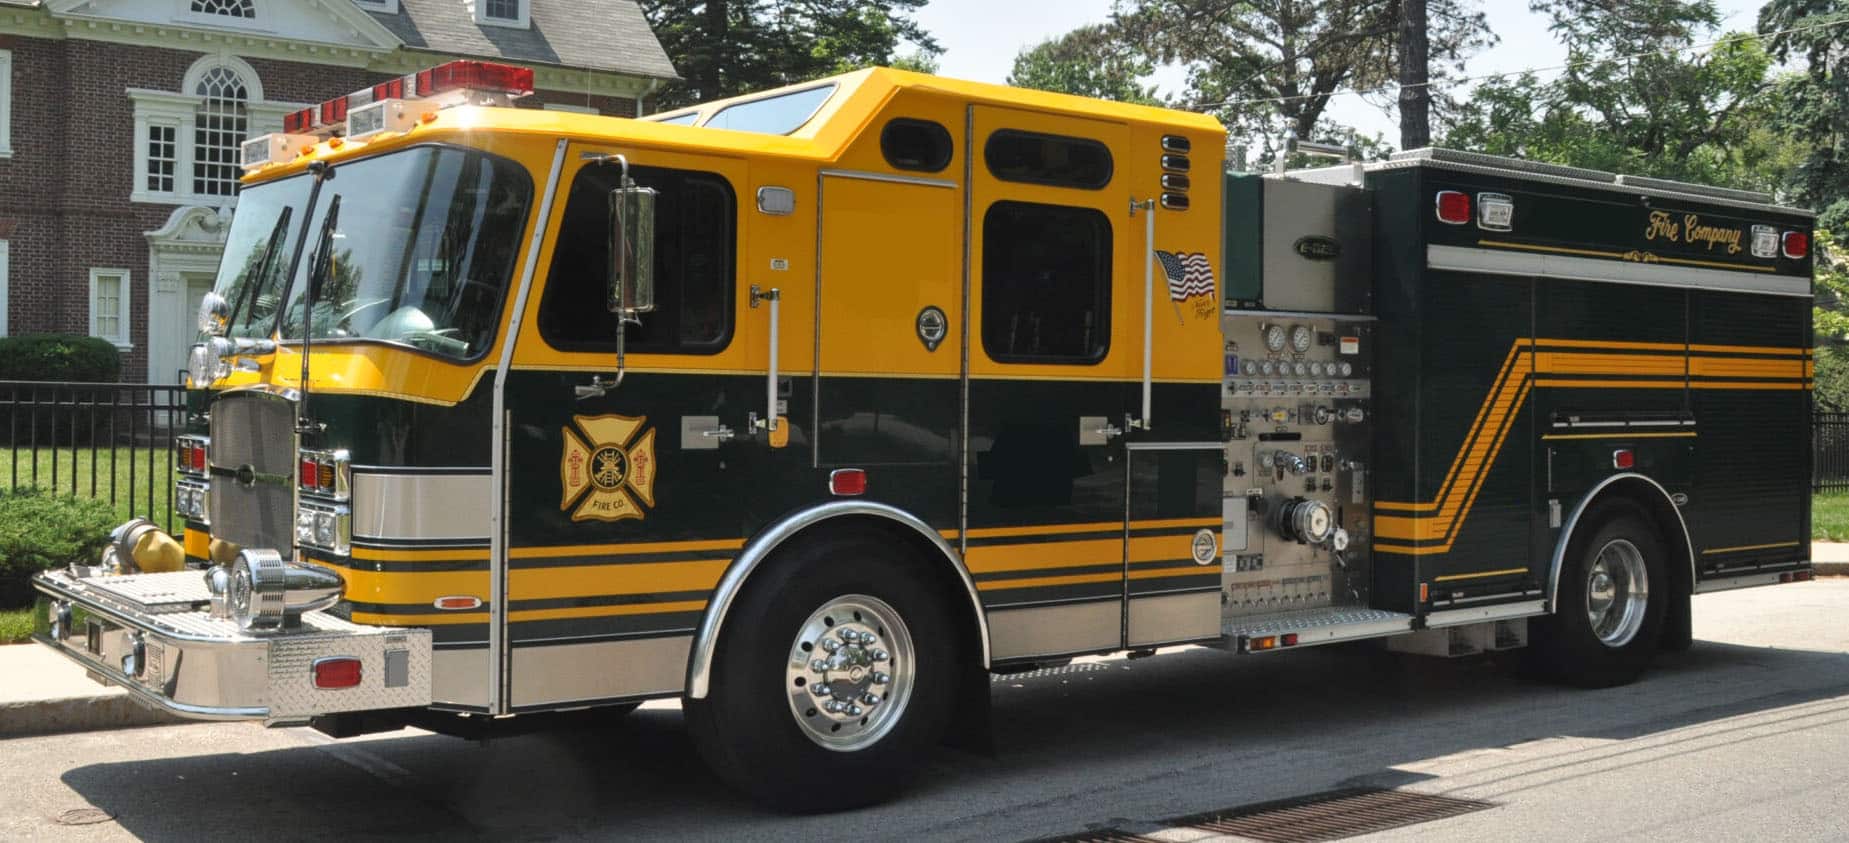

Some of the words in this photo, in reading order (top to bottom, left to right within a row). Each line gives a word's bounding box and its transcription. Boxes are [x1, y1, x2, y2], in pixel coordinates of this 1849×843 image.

[1646, 211, 1679, 242] Fire
[1684, 214, 1742, 255] Company
[593, 500, 610, 511] FIRE
